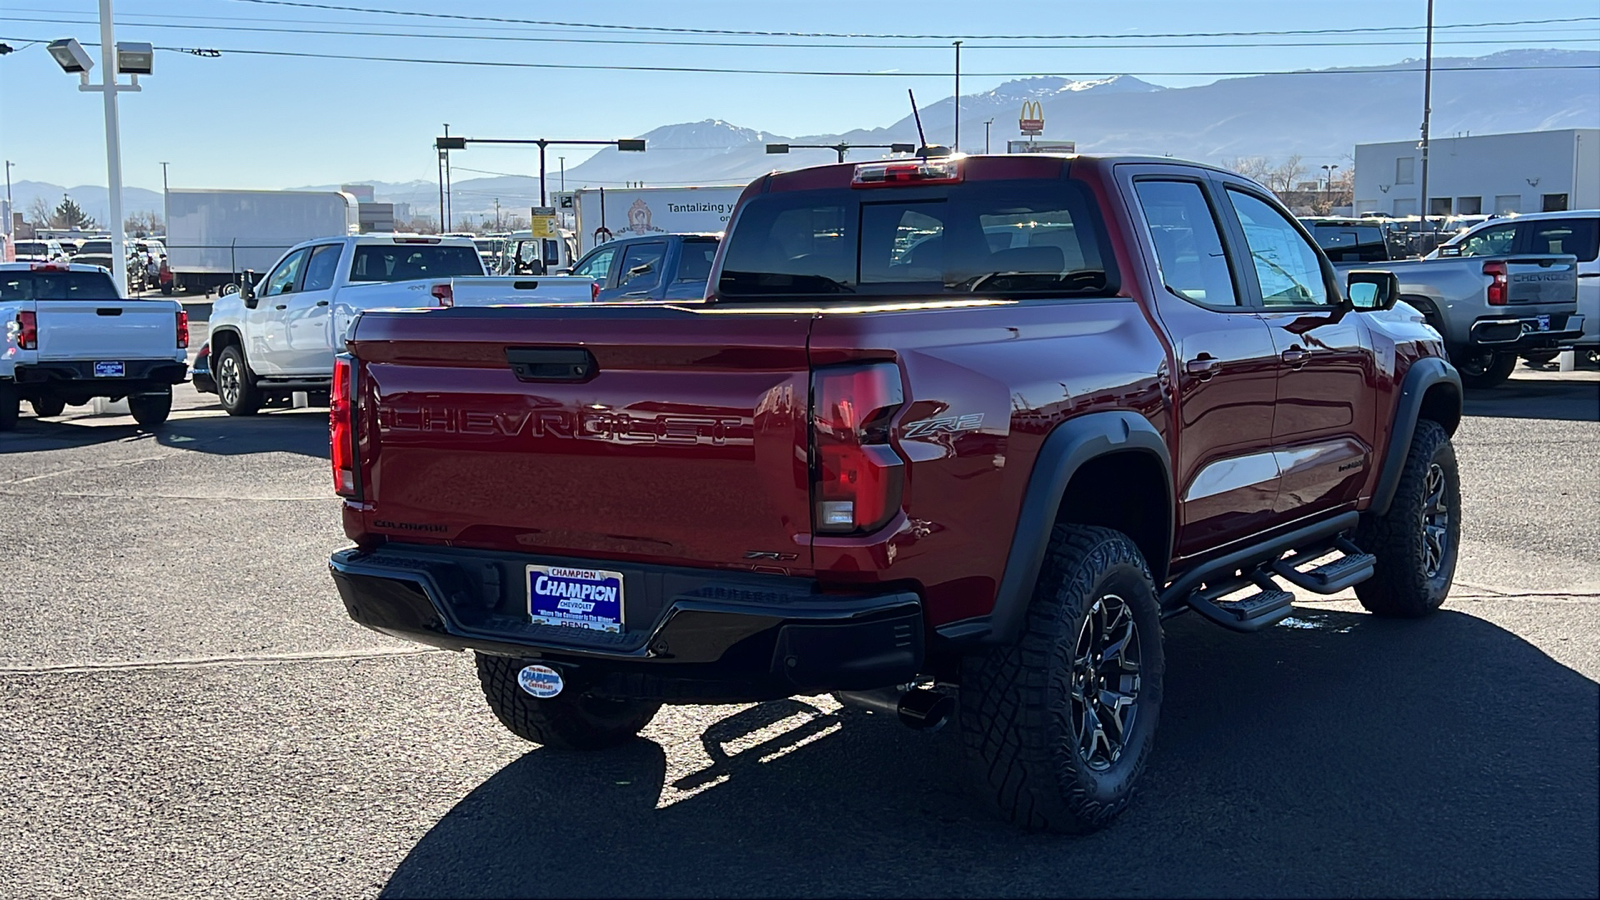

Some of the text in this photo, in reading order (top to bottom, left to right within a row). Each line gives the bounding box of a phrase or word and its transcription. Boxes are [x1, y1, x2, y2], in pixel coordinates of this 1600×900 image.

[667, 202, 735, 214] Tantalizing y
[1513, 273, 1573, 283] CHEVROLET
[380, 405, 742, 446] CHEVROLET
[902, 413, 984, 438] ZR2
[551, 568, 597, 579] CHAMPION
[535, 576, 617, 602] CHAMPION
[560, 601, 592, 610] CHEVROLET
